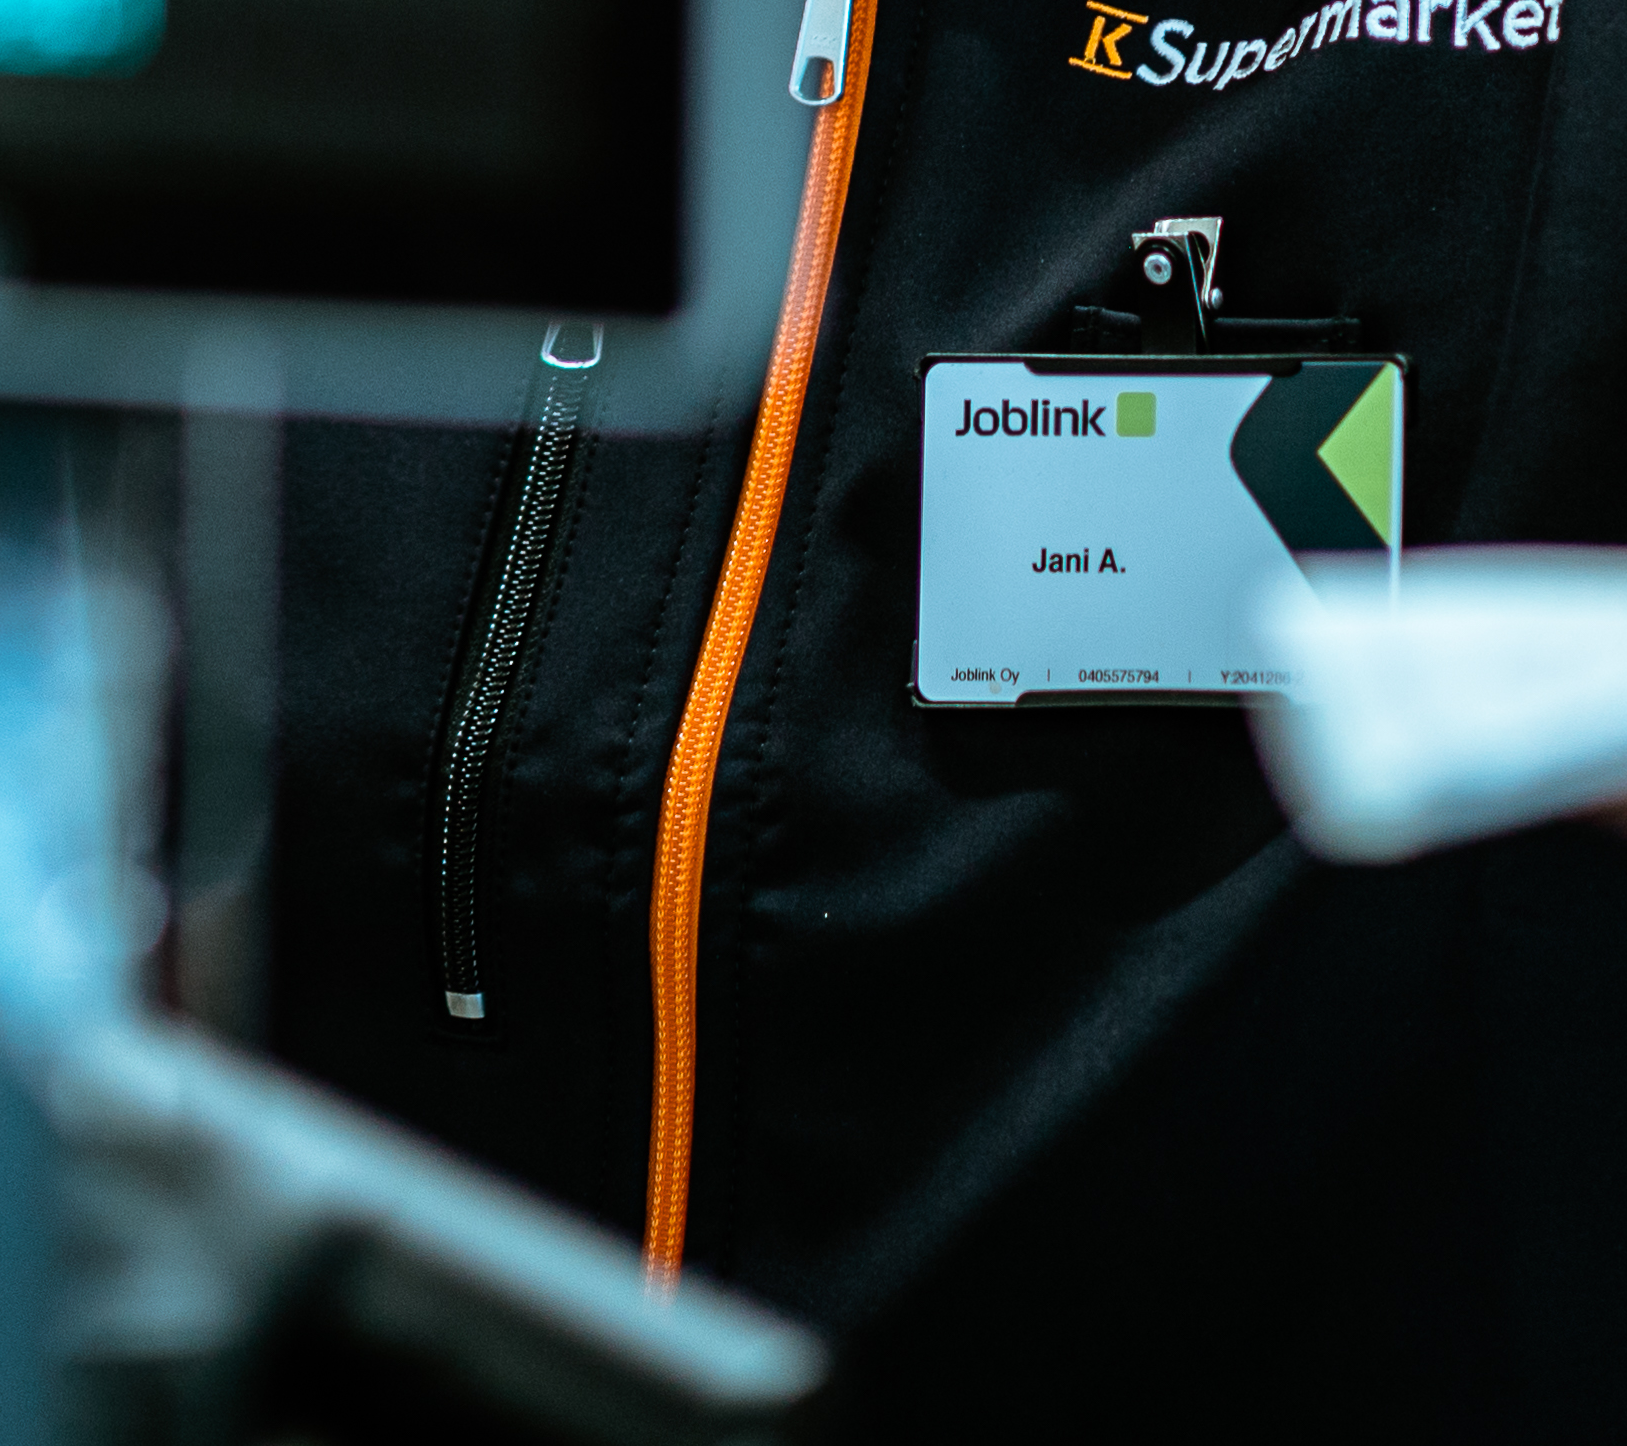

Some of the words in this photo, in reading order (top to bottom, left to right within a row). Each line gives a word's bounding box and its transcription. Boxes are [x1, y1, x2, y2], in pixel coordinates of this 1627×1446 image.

[955, 398, 1107, 437] Joblink
[1032, 547, 1089, 573] Jani
[1098, 547, 1126, 573] A.
[951, 668, 996, 682] Joblink
[1000, 667, 1020, 686] Oy
[1078, 669, 1160, 684] 0405575794
